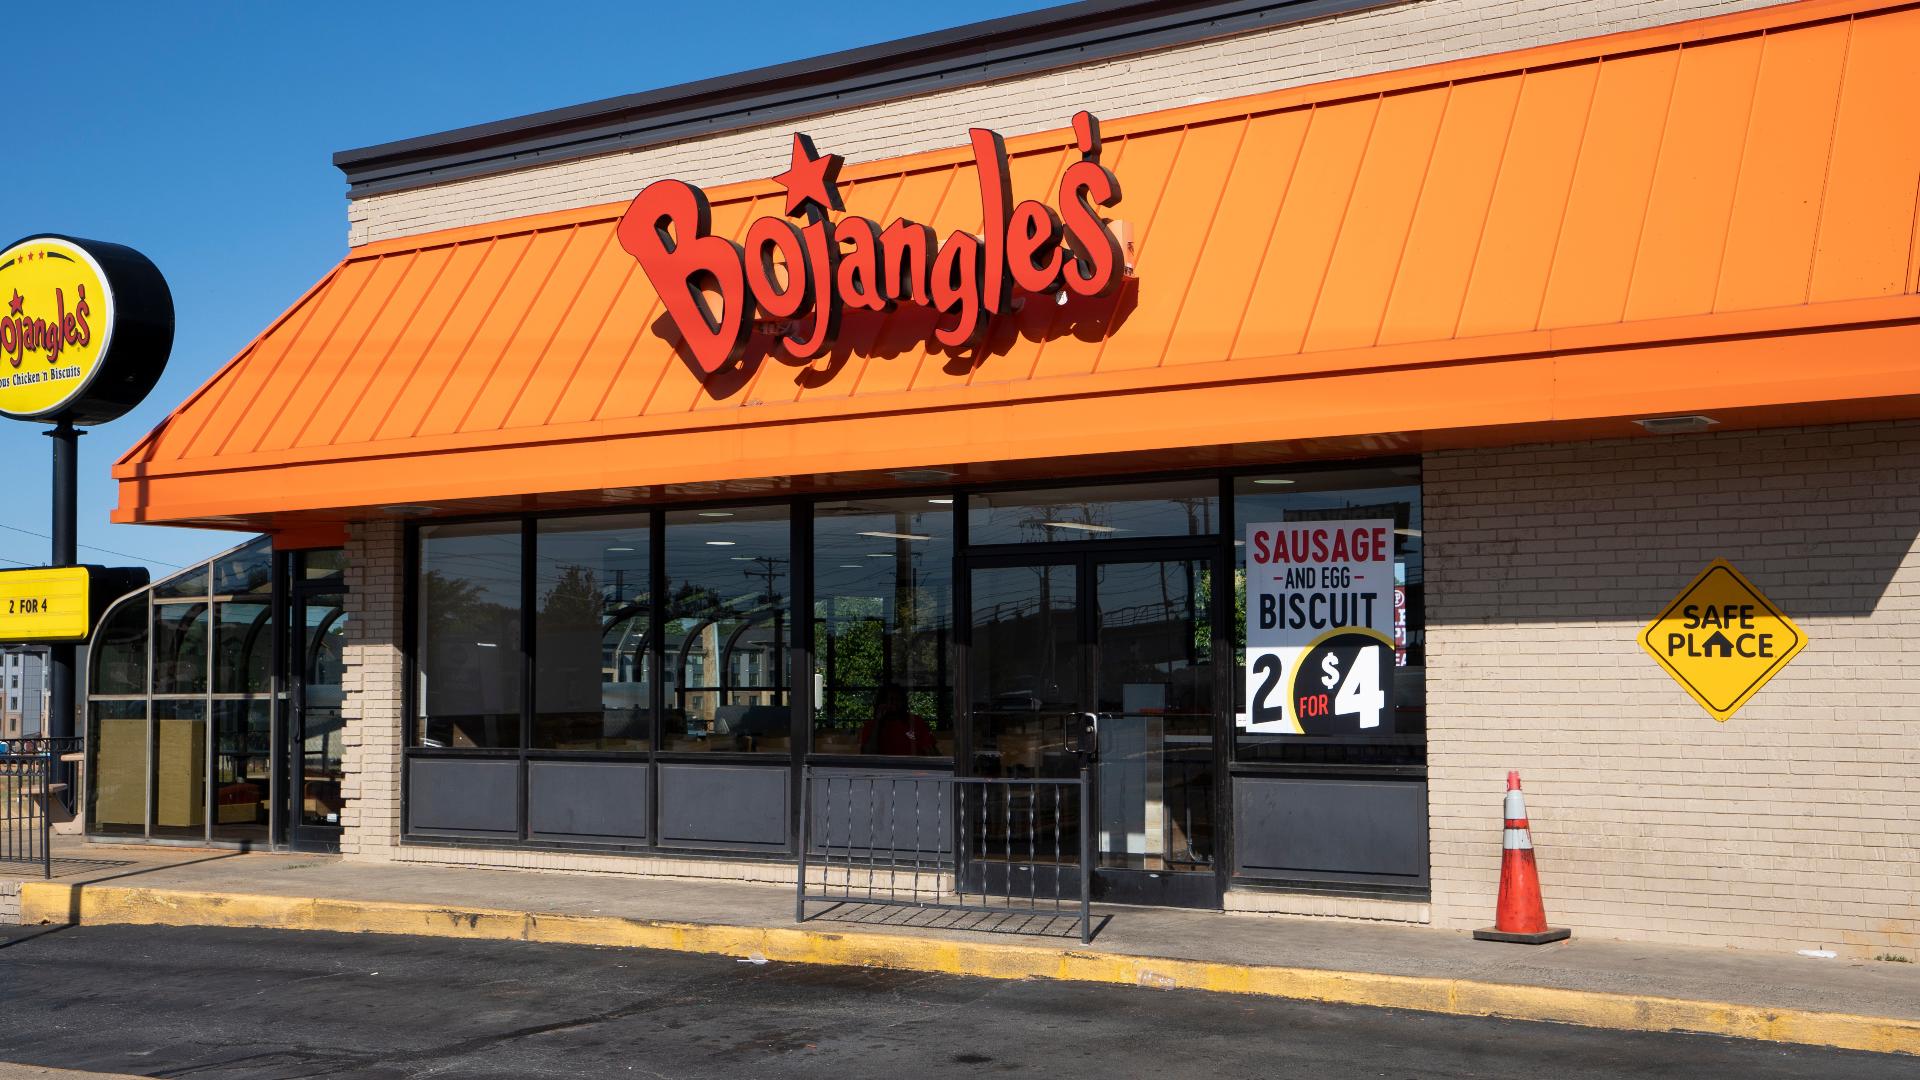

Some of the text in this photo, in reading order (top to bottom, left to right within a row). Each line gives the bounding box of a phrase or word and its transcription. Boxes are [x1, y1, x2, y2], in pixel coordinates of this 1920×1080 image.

[12, 371, 41, 386] Chicken
[50, 365, 81, 380] Biscuits
[1253, 527, 1386, 564] SAUSAGE
[1285, 566, 1351, 589] AND EGG
[9, 598, 48, 614] 2 FOR 4
[1259, 592, 1378, 630] BISCUIT
[1683, 604, 1755, 629] SAFE
[1252, 653, 1283, 725] 2
[1300, 694, 1329, 718] FOR
